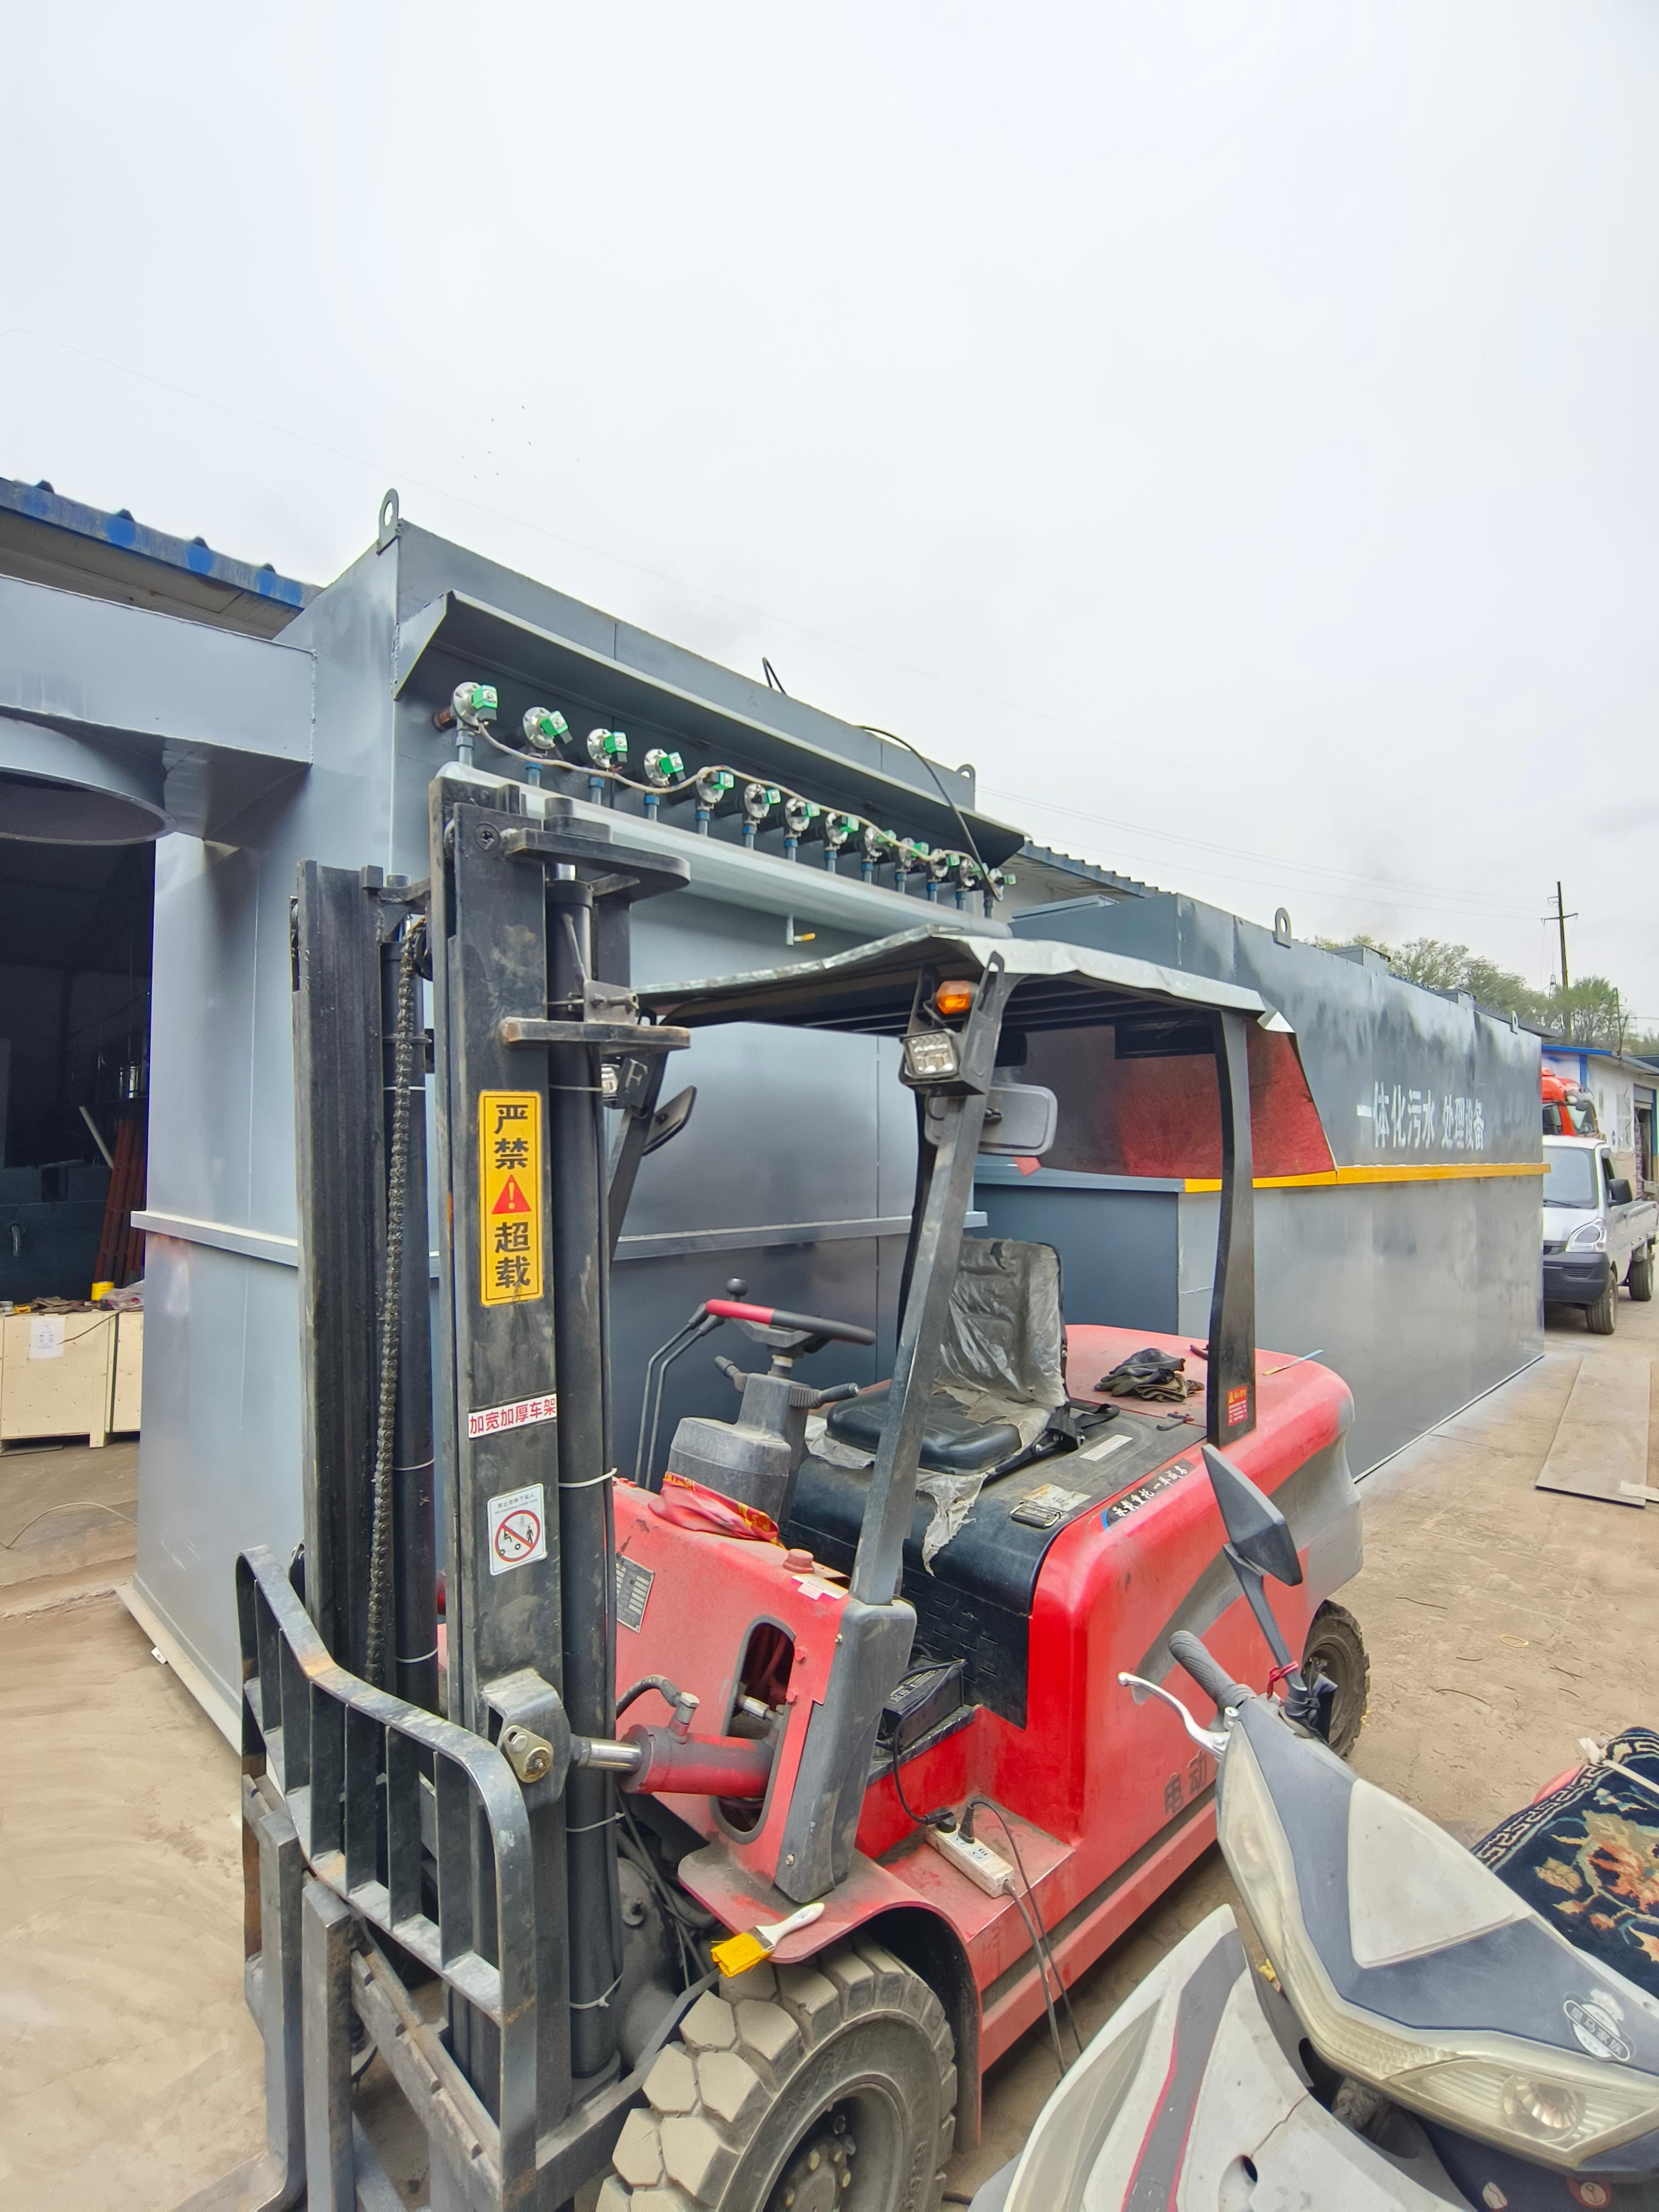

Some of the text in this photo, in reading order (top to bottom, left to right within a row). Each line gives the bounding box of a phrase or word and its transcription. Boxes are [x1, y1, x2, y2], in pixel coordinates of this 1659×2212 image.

[1357, 1081, 1435, 1148] 一体化污水
[494, 1104, 530, 1289] 严禁 超载
[470, 1398, 556, 1434] 加宽加厚车架
